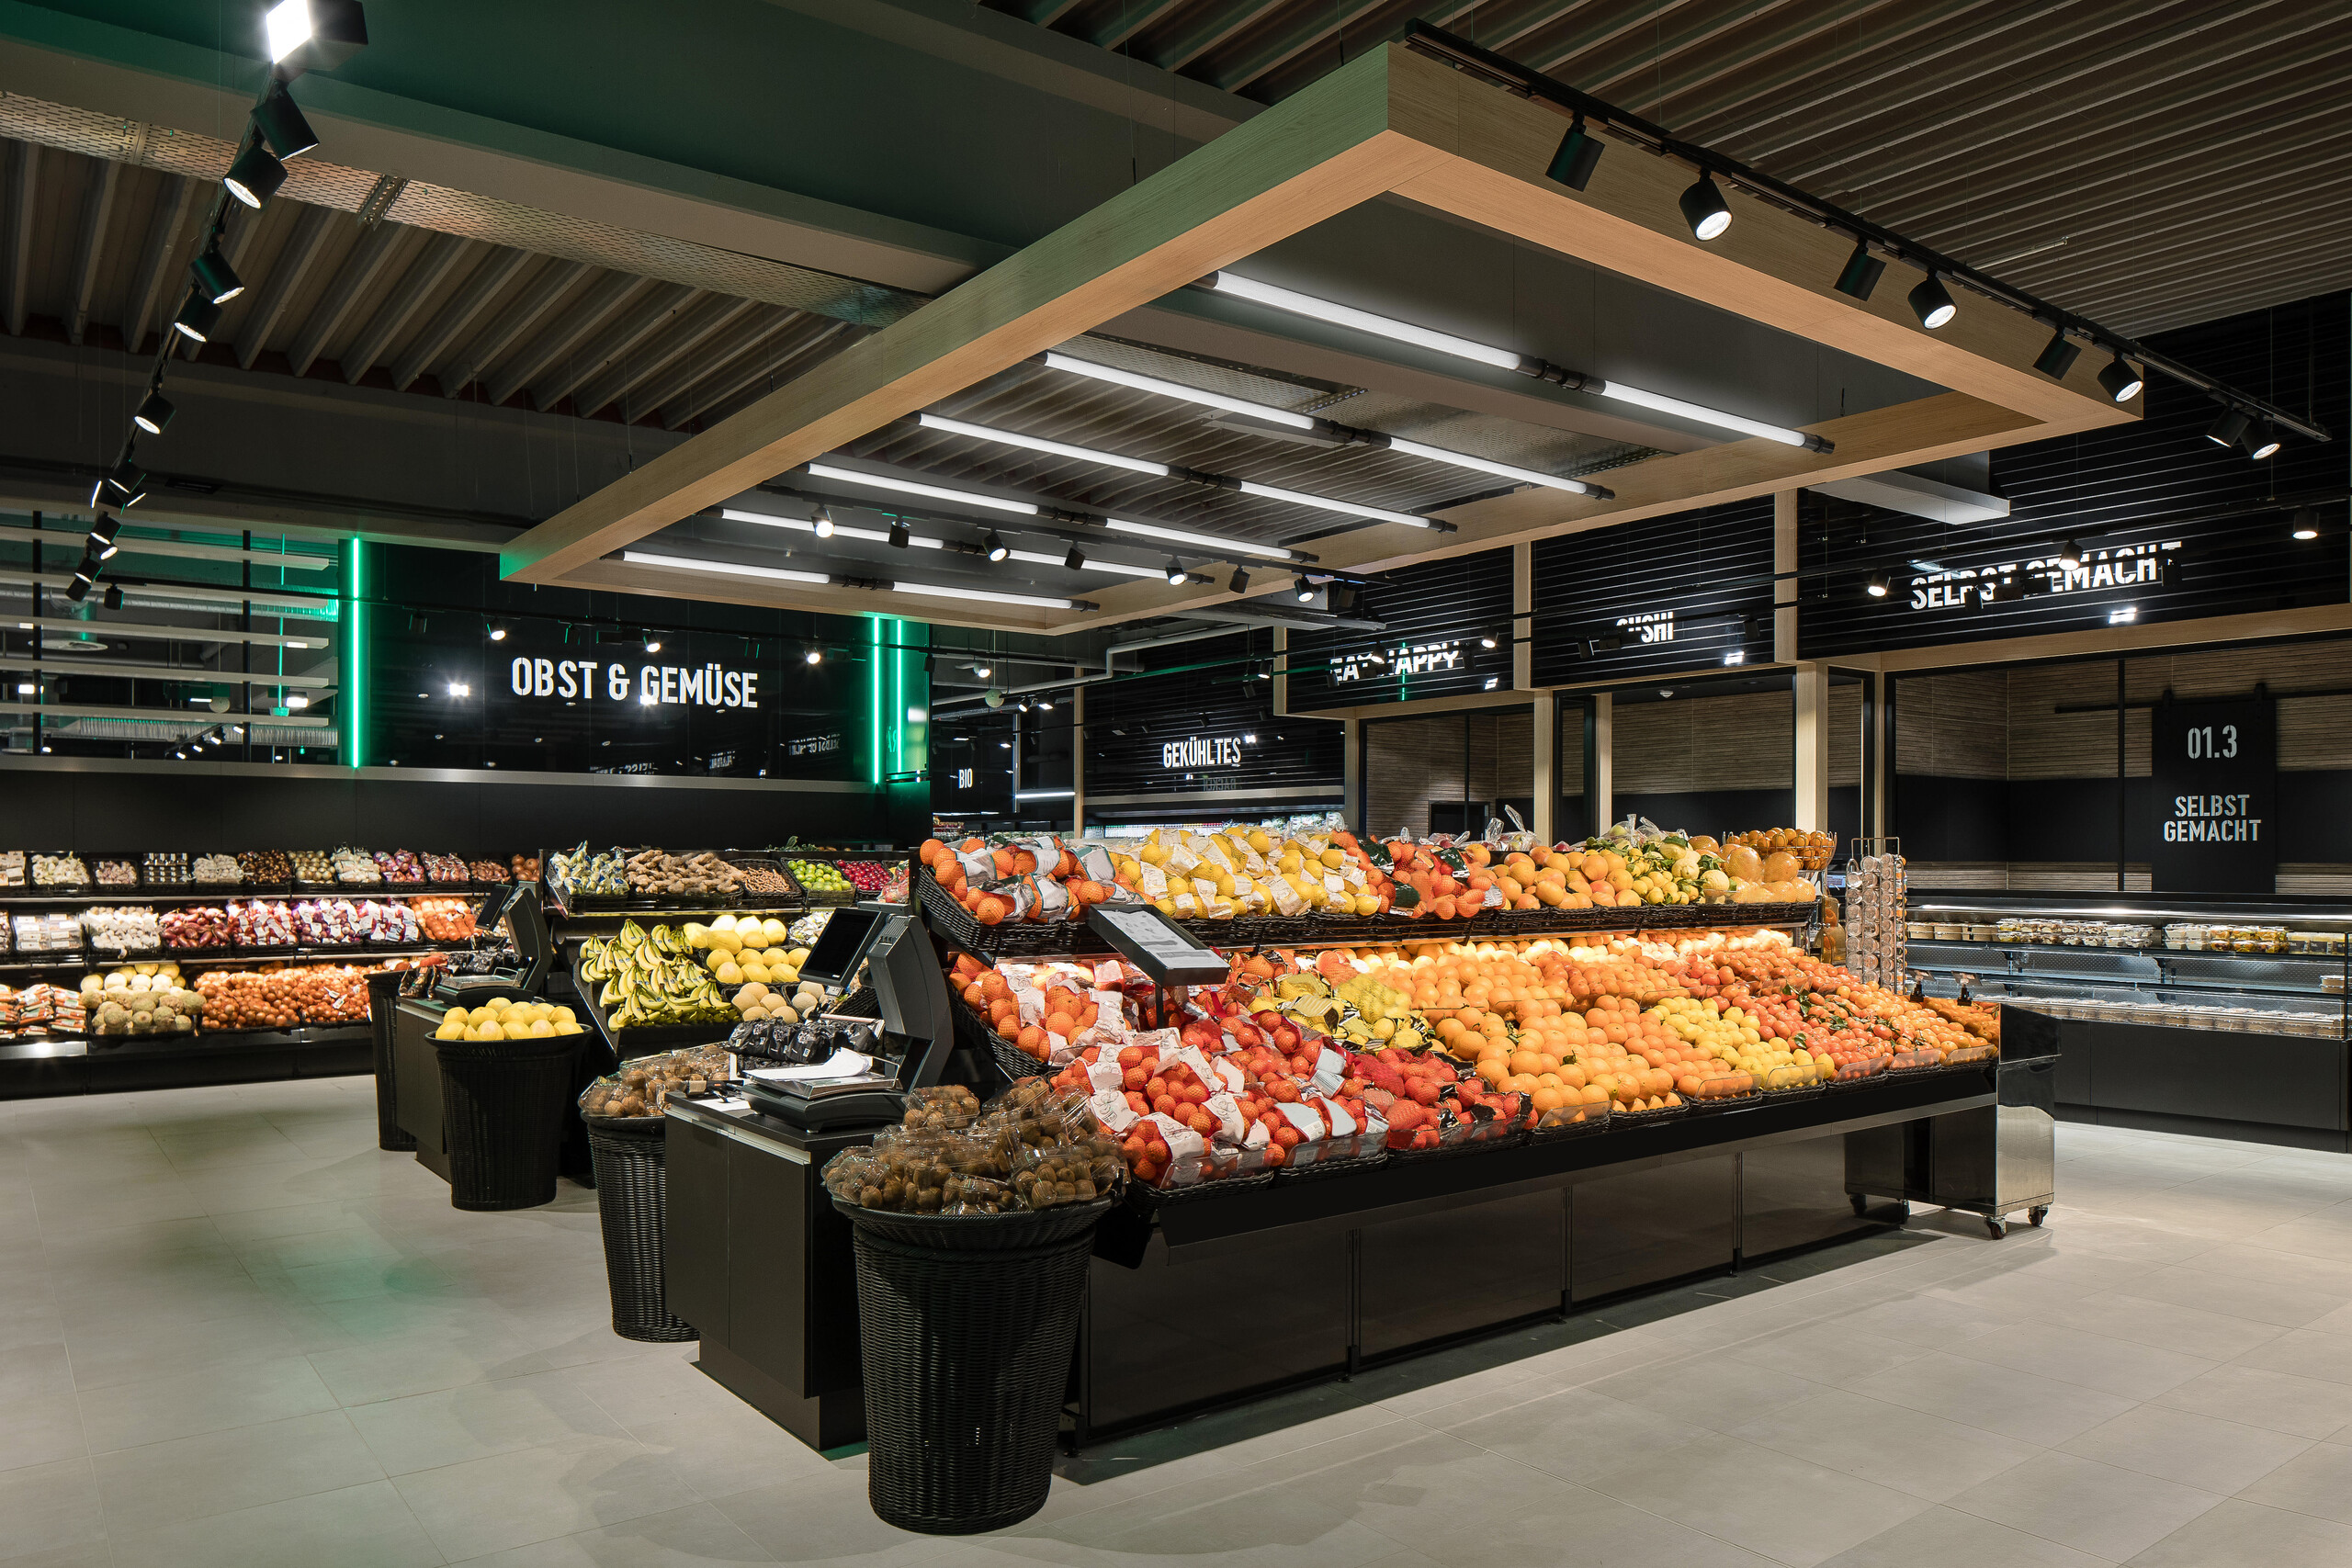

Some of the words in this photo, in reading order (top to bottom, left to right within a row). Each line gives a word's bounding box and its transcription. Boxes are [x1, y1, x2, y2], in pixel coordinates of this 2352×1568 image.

[511, 657, 598, 699] OBST
[608, 662, 630, 701] &
[640, 662, 759, 708] GEMÜSE
[1163, 737, 1241, 767] GEKÜHLTES
[2188, 724, 2238, 760] 01.3
[958, 768, 973, 788] BIO
[2174, 794, 2249, 817] SELBST
[2164, 818, 2261, 841] GEMACHT
